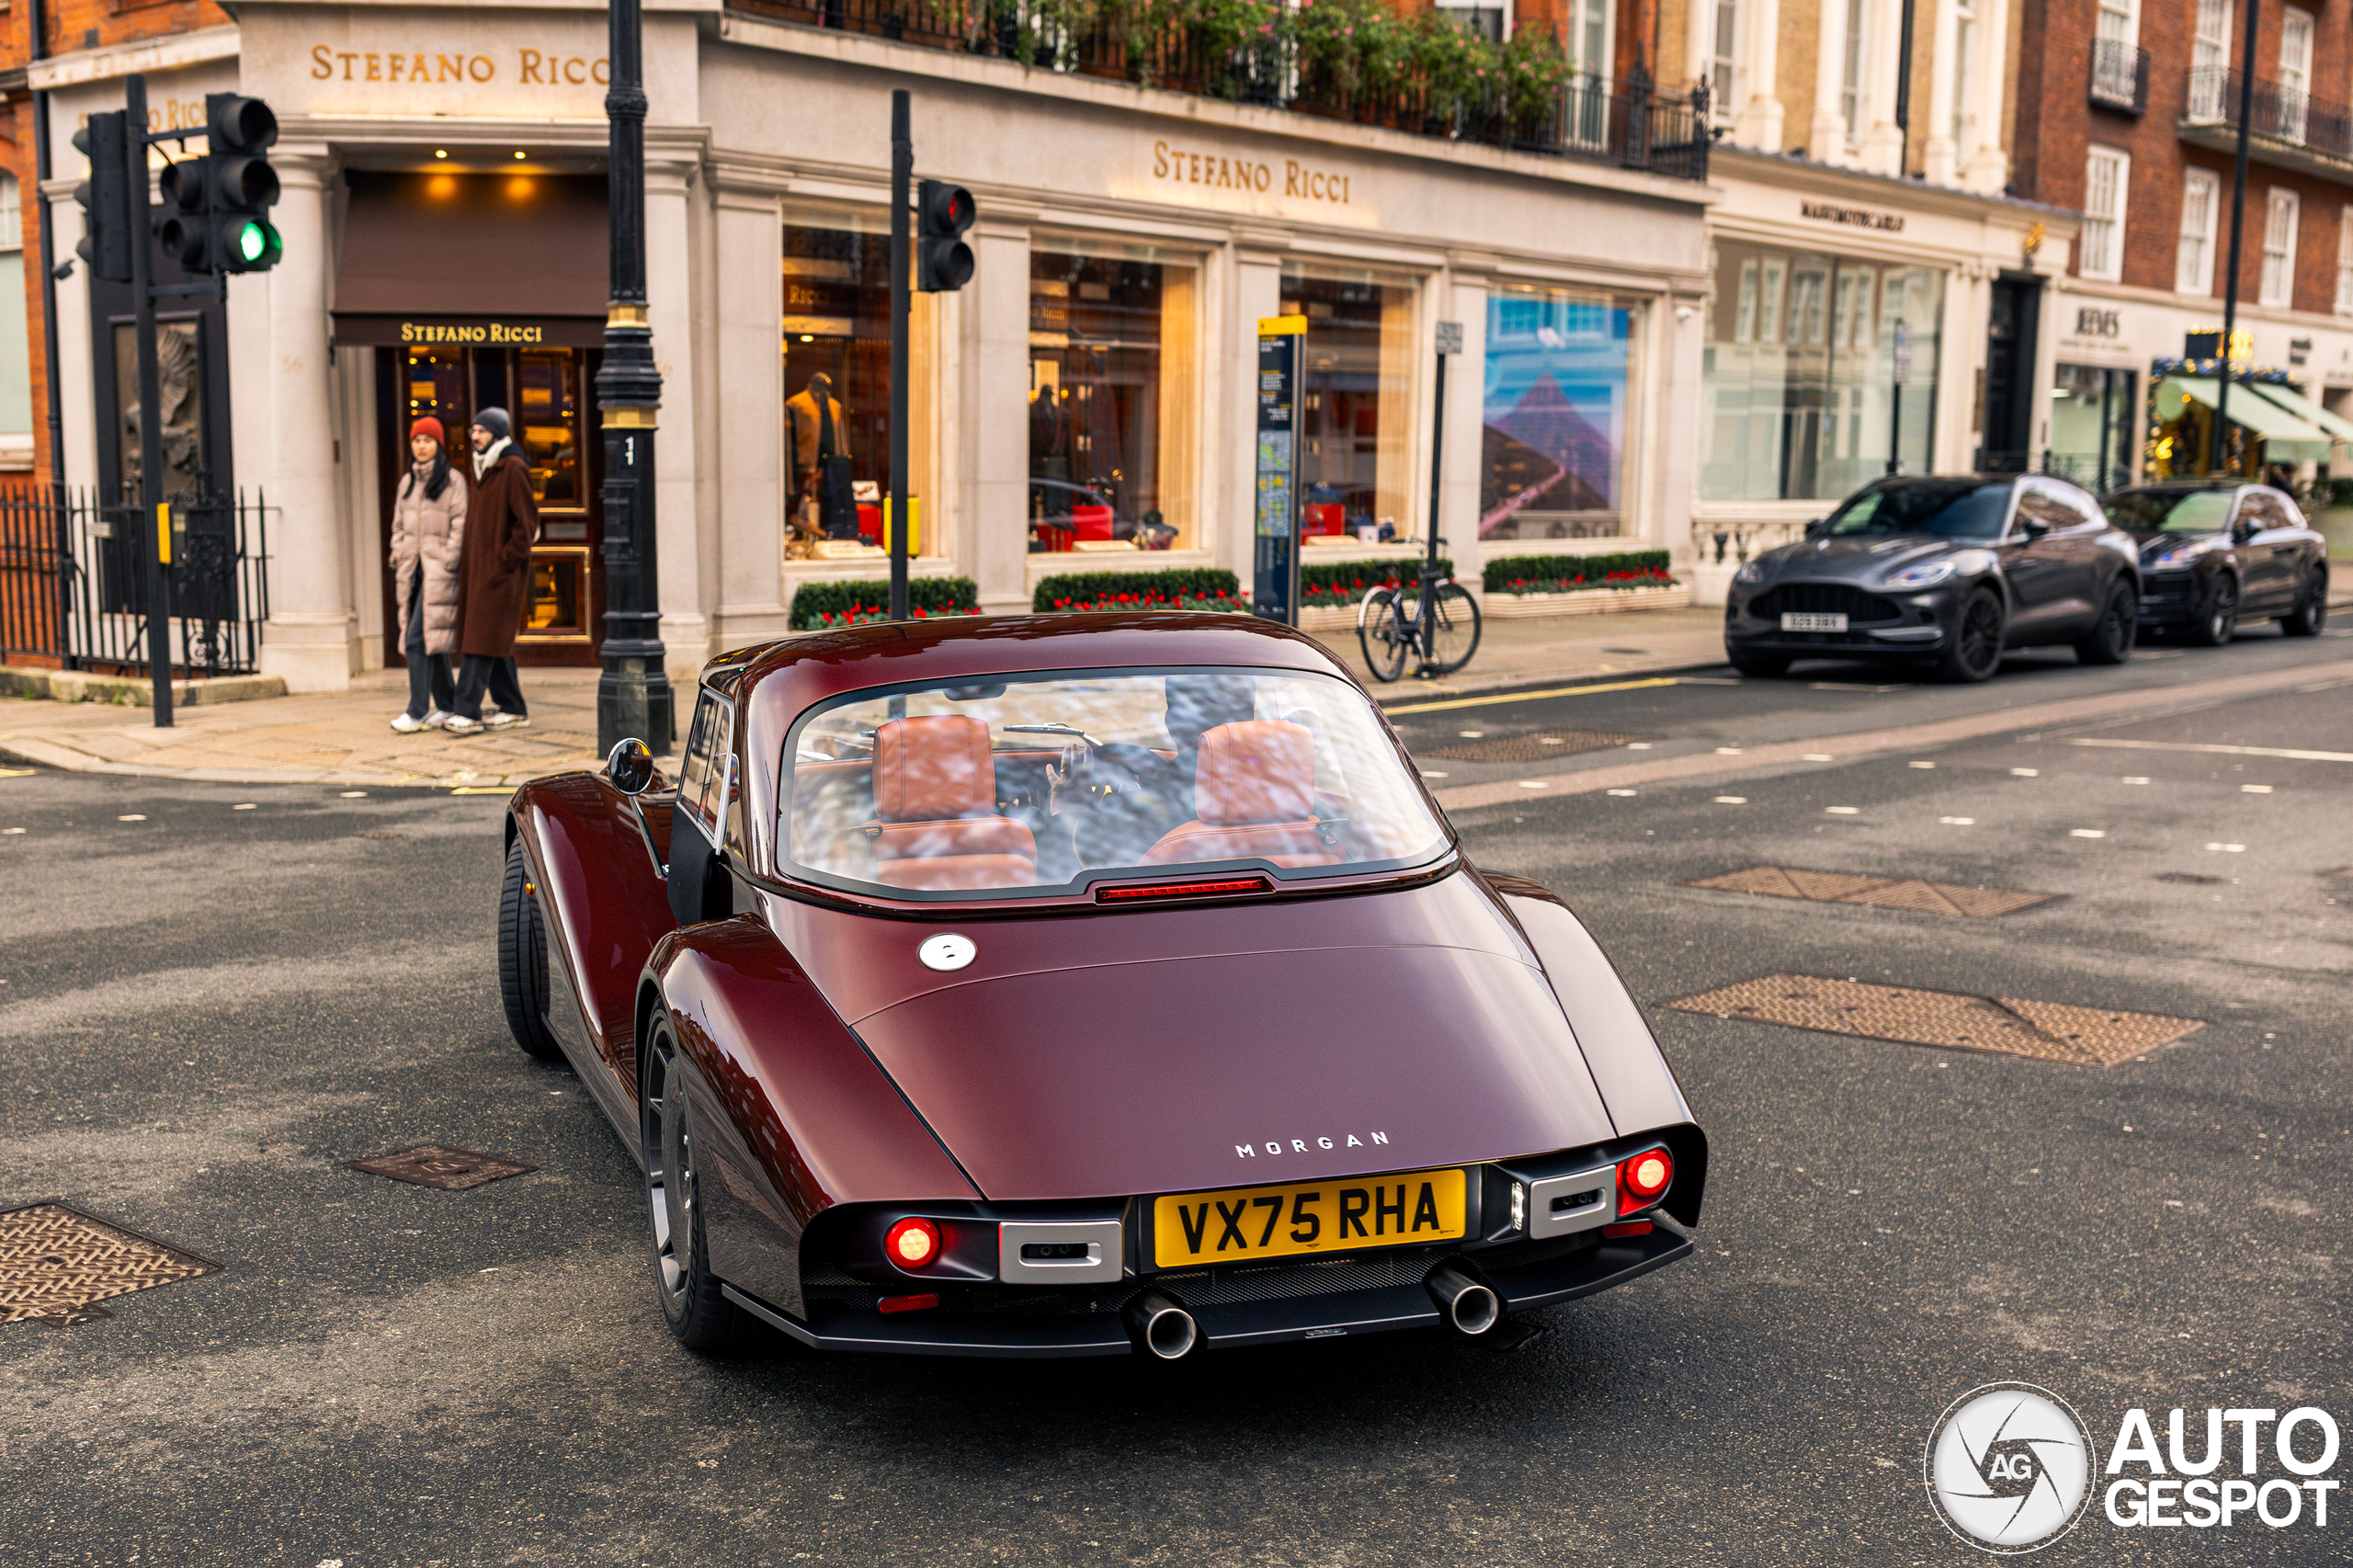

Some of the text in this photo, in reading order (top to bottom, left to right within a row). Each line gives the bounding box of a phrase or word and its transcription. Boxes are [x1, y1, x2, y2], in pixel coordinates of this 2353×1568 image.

[311, 44, 609, 85] STEFANO RICC
[166, 98, 208, 131] RIC
[1153, 140, 1349, 204] STEFANO RICCI
[401, 323, 542, 342] STEFANO RICCI
[1234, 1131, 1390, 1158] MORGAN
[1177, 1182, 1440, 1255] VX75 RHA
